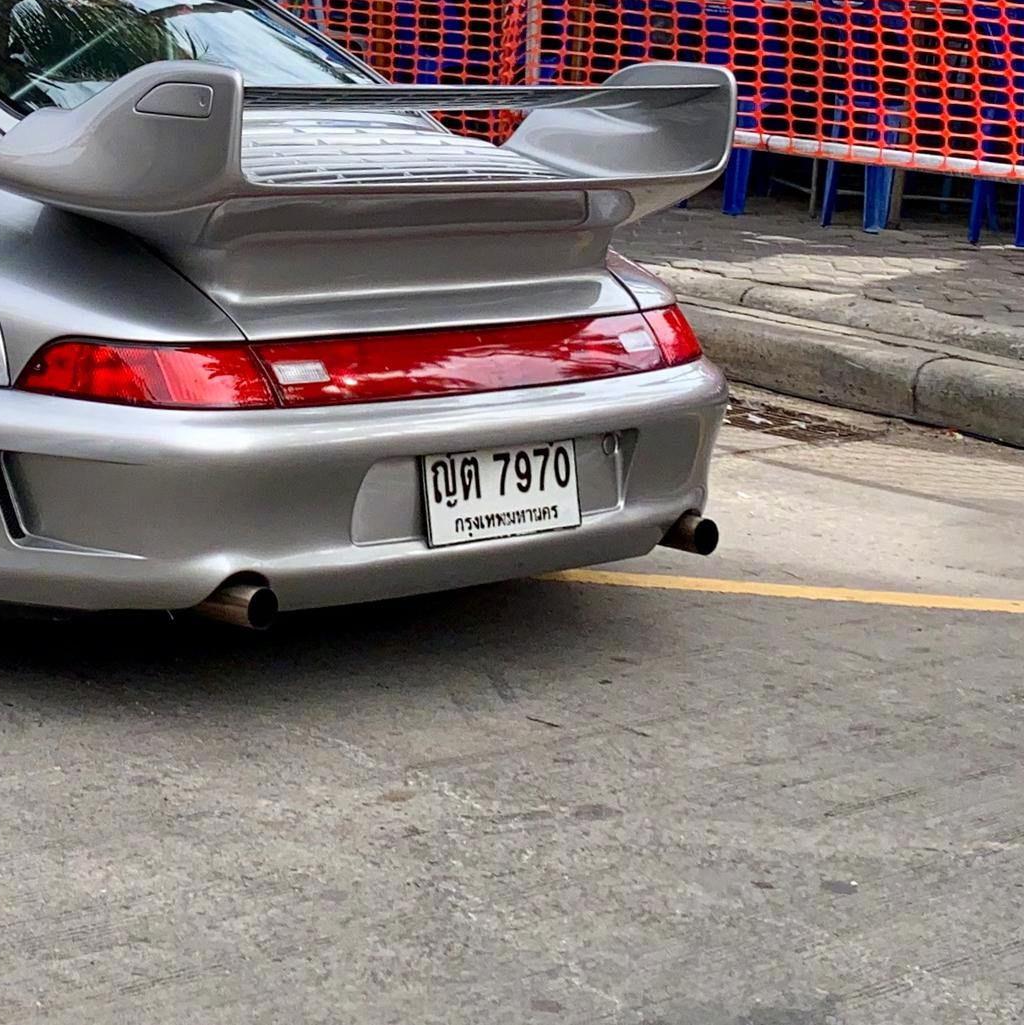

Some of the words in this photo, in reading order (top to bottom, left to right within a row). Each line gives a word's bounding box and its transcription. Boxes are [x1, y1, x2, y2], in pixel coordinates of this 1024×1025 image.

[431, 455, 482, 508] ญต
[493, 446, 571, 496] 7970
[455, 505, 559, 537] กรุงเทพมหานคร
